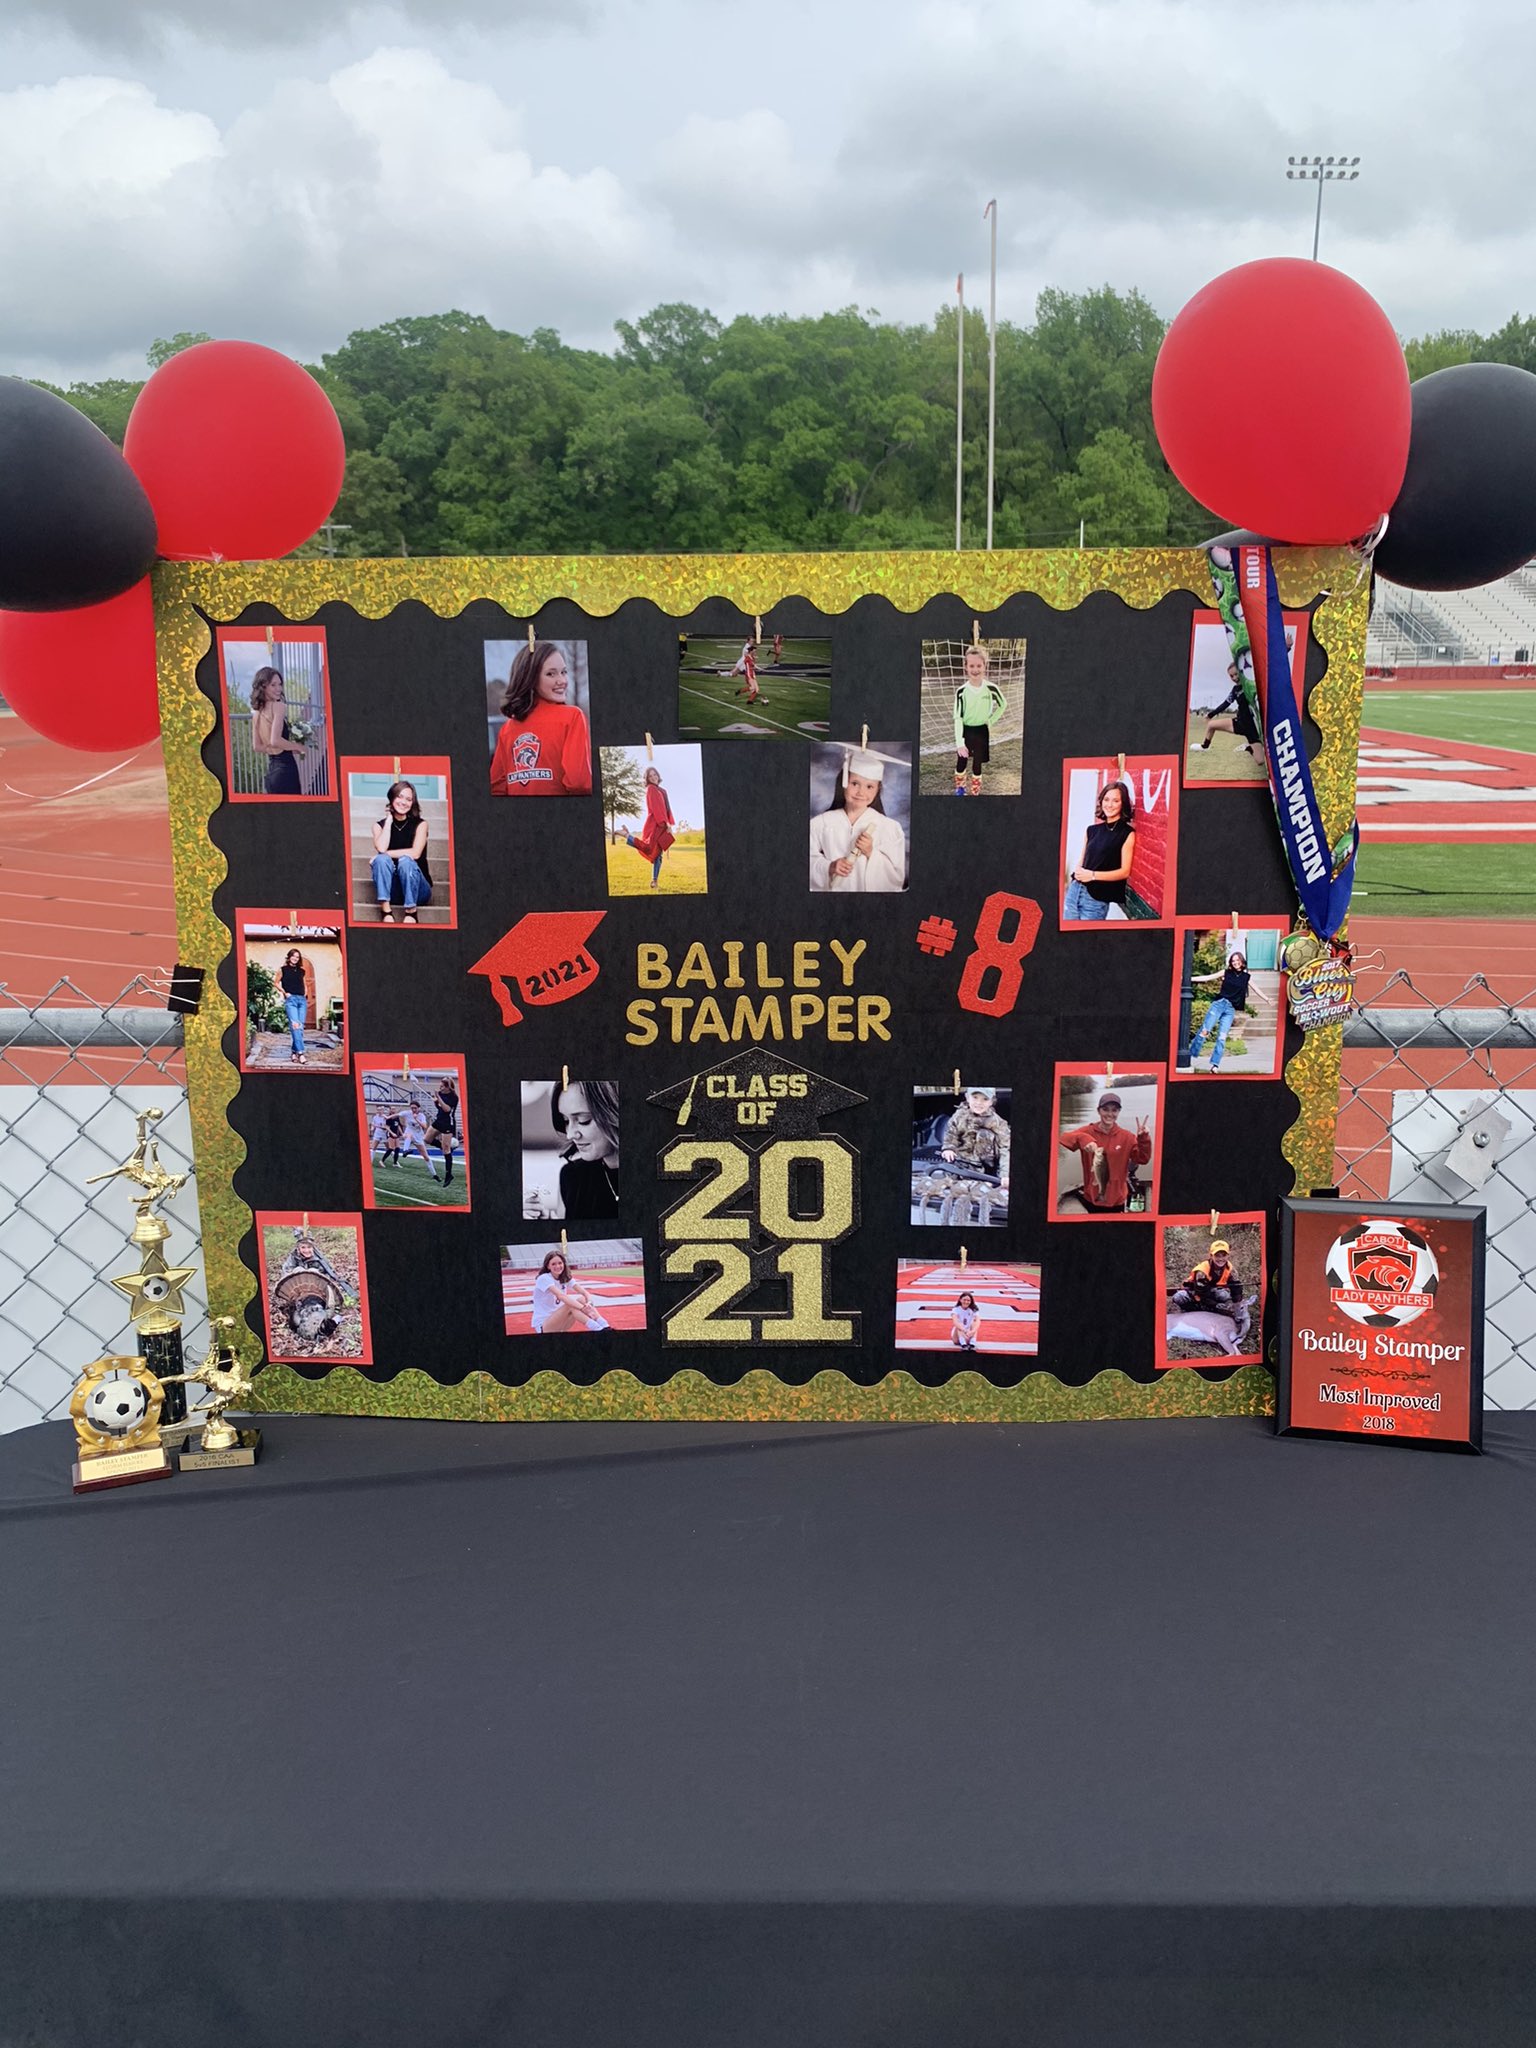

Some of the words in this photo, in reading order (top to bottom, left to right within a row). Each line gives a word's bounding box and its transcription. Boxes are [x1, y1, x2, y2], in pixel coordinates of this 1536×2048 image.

[1272, 718, 1326, 885] CHAMPION
[637, 939, 867, 990] BAILEY
[916, 890, 1044, 1018] #8
[1322, 960, 1341, 971] 2017
[525, 954, 592, 997] 2021
[1294, 967, 1345, 987] Blues
[1313, 983, 1347, 1002] City
[1294, 999, 1330, 1015] SOCCER
[625, 994, 892, 1046] STAMPER
[1302, 1012, 1353, 1031] CHAMPION
[706, 1074, 808, 1098] CLASS
[736, 1101, 777, 1125] OF
[664, 1140, 853, 1240] 20
[1364, 1234, 1401, 1245] CABOT
[666, 1244, 853, 1341] 21
[1334, 1290, 1365, 1302] LADY
[1367, 1292, 1430, 1306] PANTHERS
[1298, 1328, 1368, 1361] Bailey
[1374, 1333, 1466, 1366] Stamper
[1319, 1384, 1360, 1404] Most
[1362, 1387, 1441, 1412] Improved
[1362, 1416, 1395, 1431] 2018
[208, 1458, 240, 1467] FINALIST
